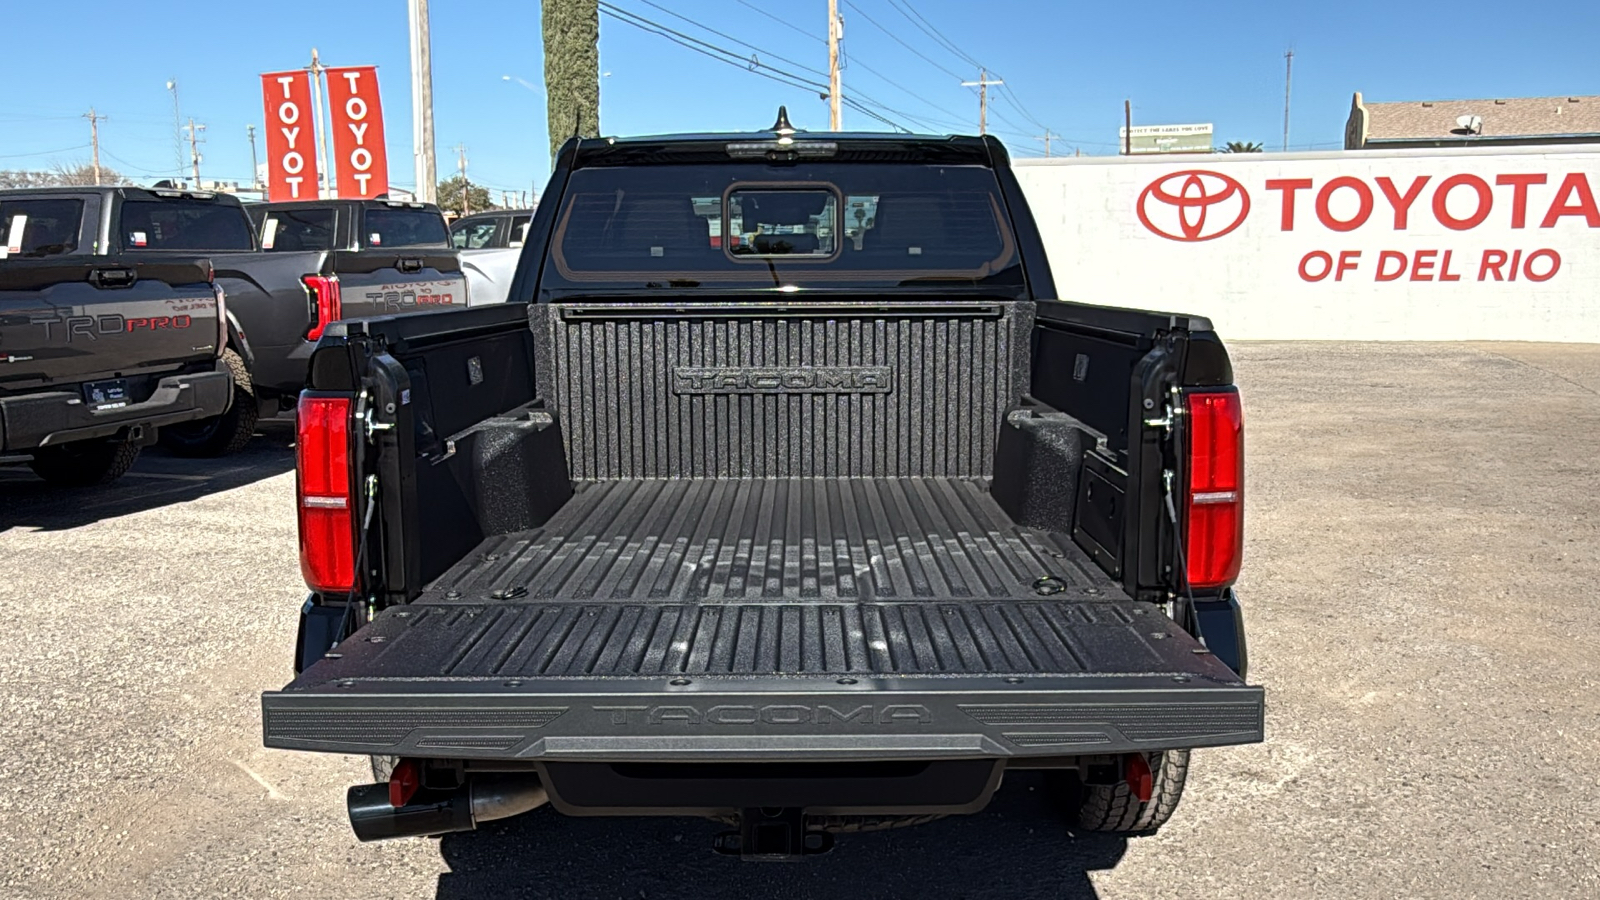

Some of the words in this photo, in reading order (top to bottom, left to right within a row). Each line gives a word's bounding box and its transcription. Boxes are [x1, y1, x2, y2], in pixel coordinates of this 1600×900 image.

[277, 76, 304, 199] TOYOT
[343, 72, 372, 196] TOYOT
[1265, 172, 1600, 232] TOYOTA
[1298, 249, 1362, 282] OF
[1374, 249, 1461, 282] DEL
[1477, 248, 1561, 282] RIO
[126, 315, 191, 332] PRO
[677, 372, 888, 389] TACOMA
[592, 704, 931, 725] TACOMA
